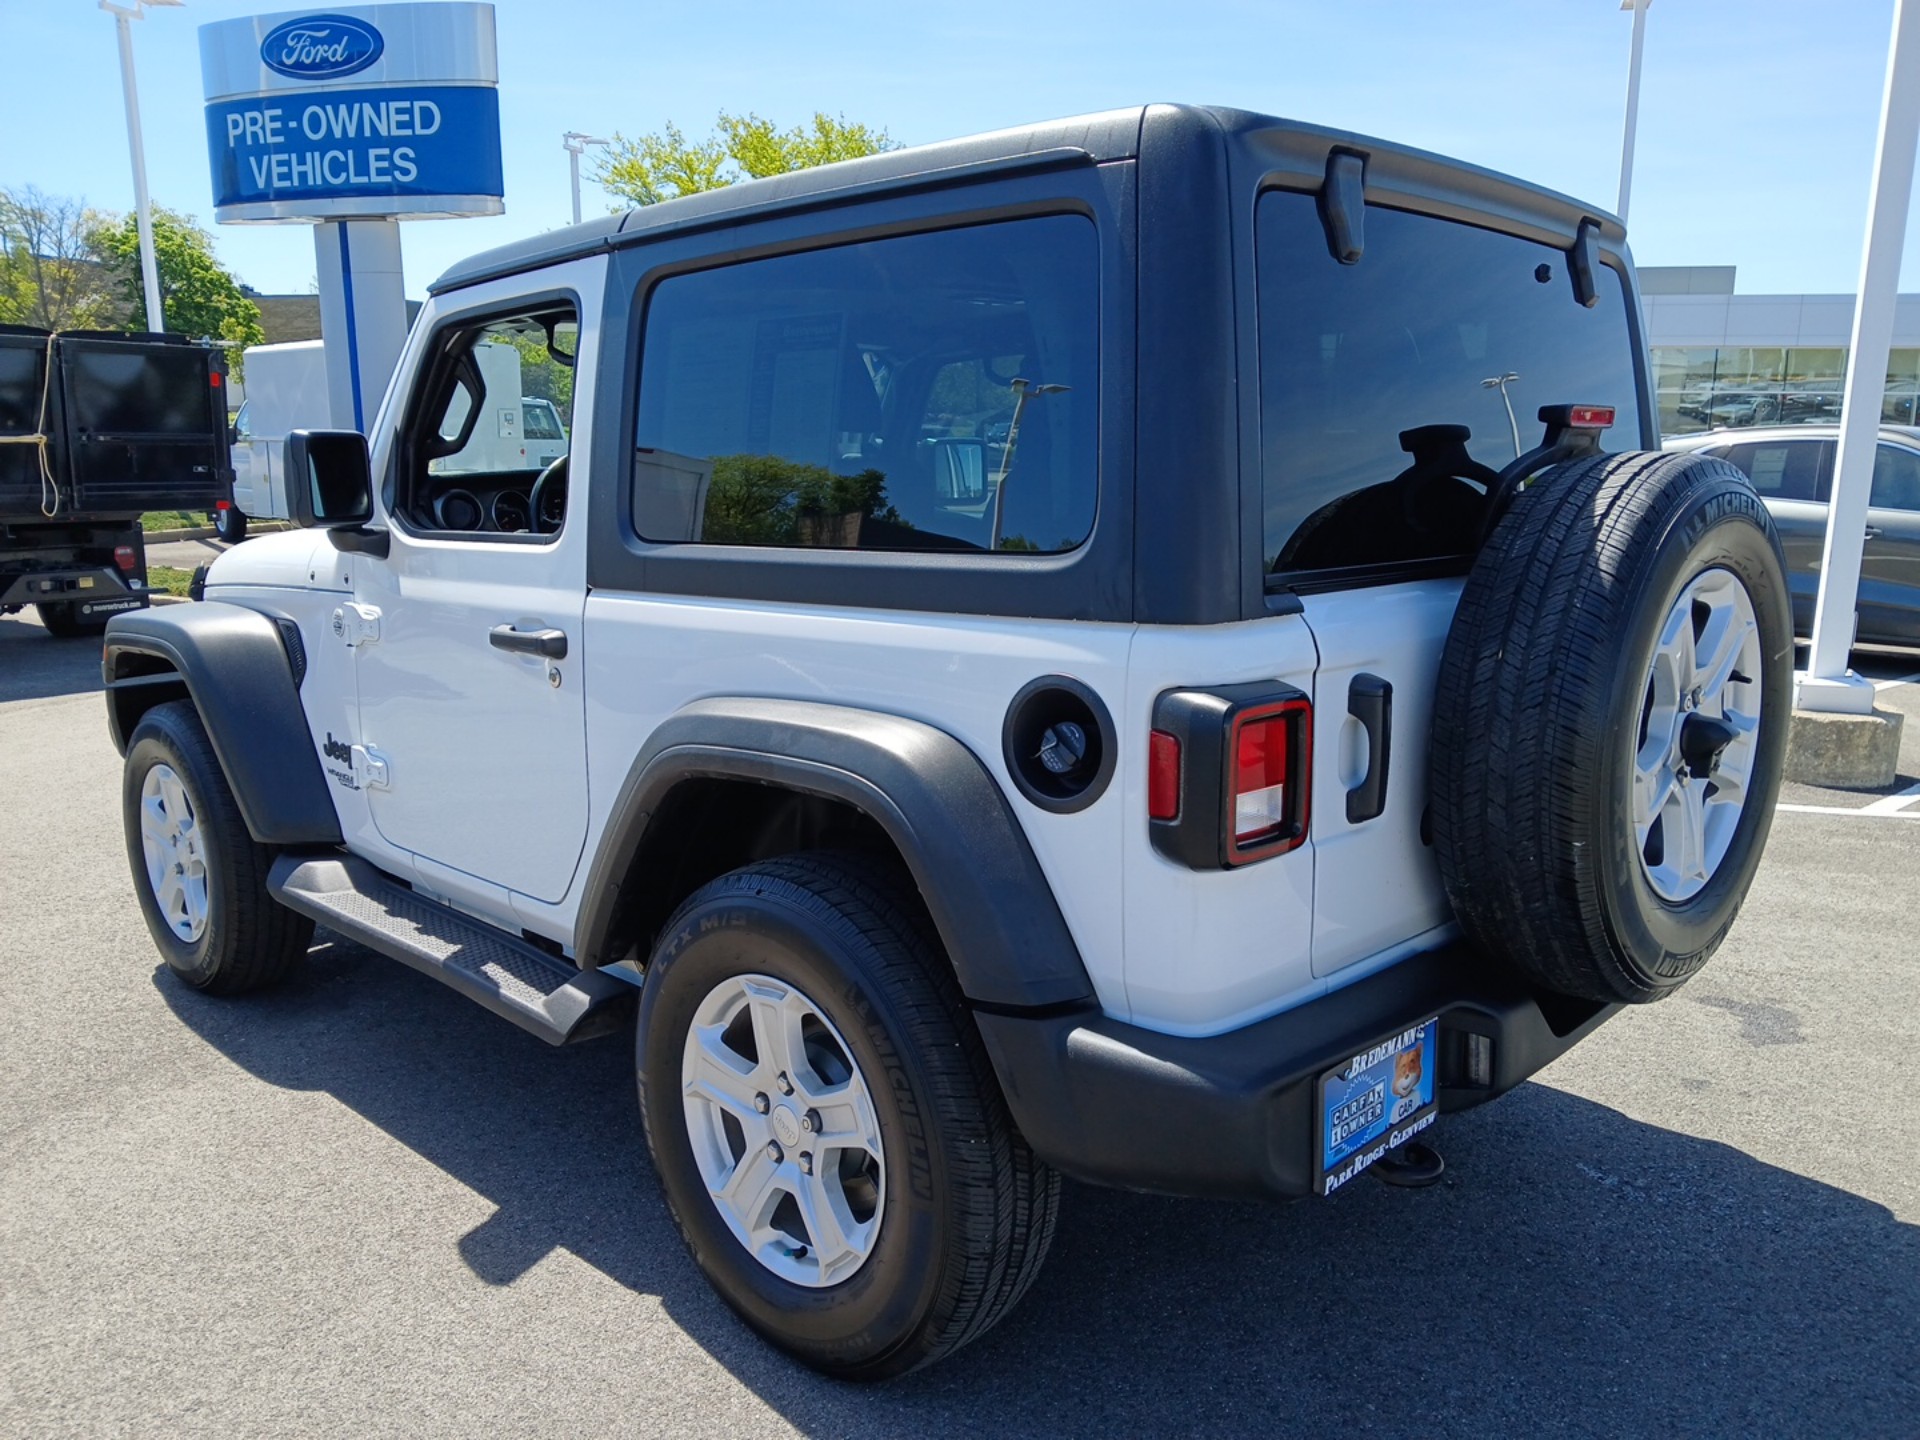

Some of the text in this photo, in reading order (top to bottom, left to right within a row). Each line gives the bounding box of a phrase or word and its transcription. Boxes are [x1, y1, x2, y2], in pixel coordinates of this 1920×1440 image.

[281, 29, 349, 65] Ford
[226, 101, 441, 147] PRE-OWNED
[249, 147, 417, 189] VEHICLES
[1704, 493, 1767, 533] MICHELIN
[867, 1023, 933, 1201] MICHELIN
[1334, 1087, 1383, 1125] CARFAX
[1342, 1103, 1382, 1137] OWNER
[1324, 1165, 1353, 1196] PARK
[1353, 1143, 1385, 1175] RIDGE
